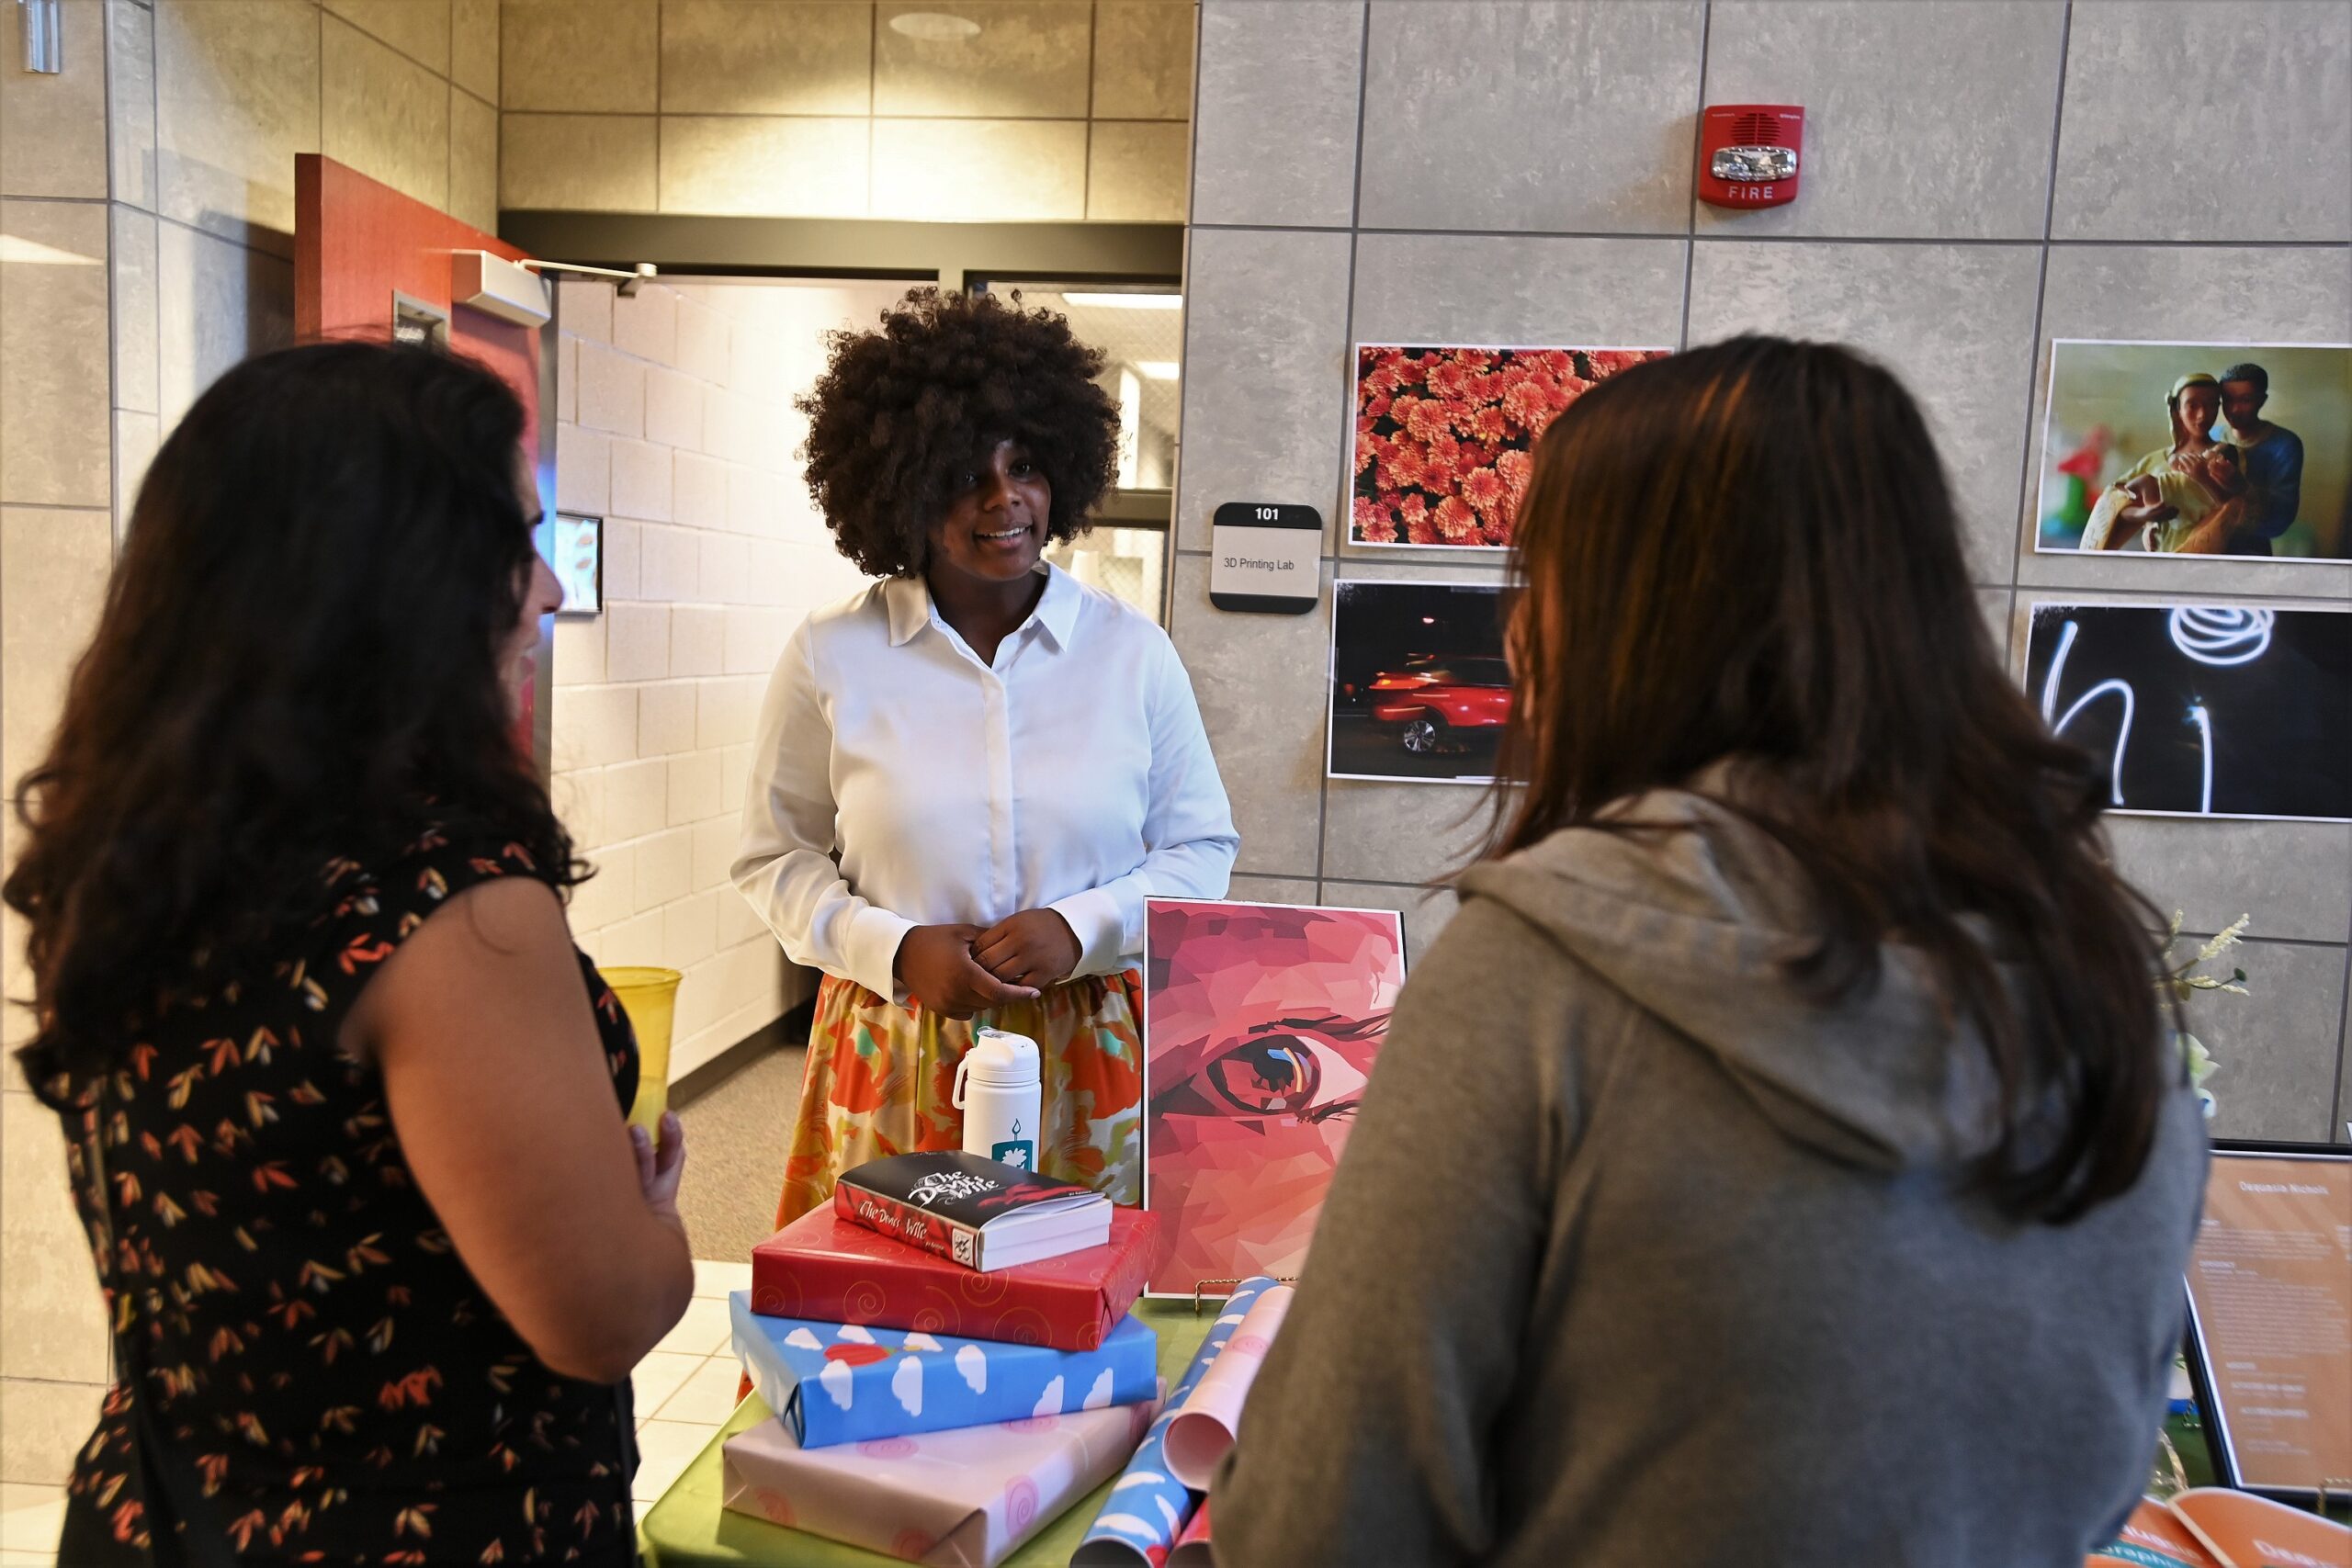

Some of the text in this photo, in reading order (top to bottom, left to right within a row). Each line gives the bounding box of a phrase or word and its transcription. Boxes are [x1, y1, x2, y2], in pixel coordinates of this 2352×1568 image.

[1728, 186, 1773, 199] FIRE
[1255, 507, 1279, 521] 101
[1224, 558, 1295, 571] 3D Printing Lab
